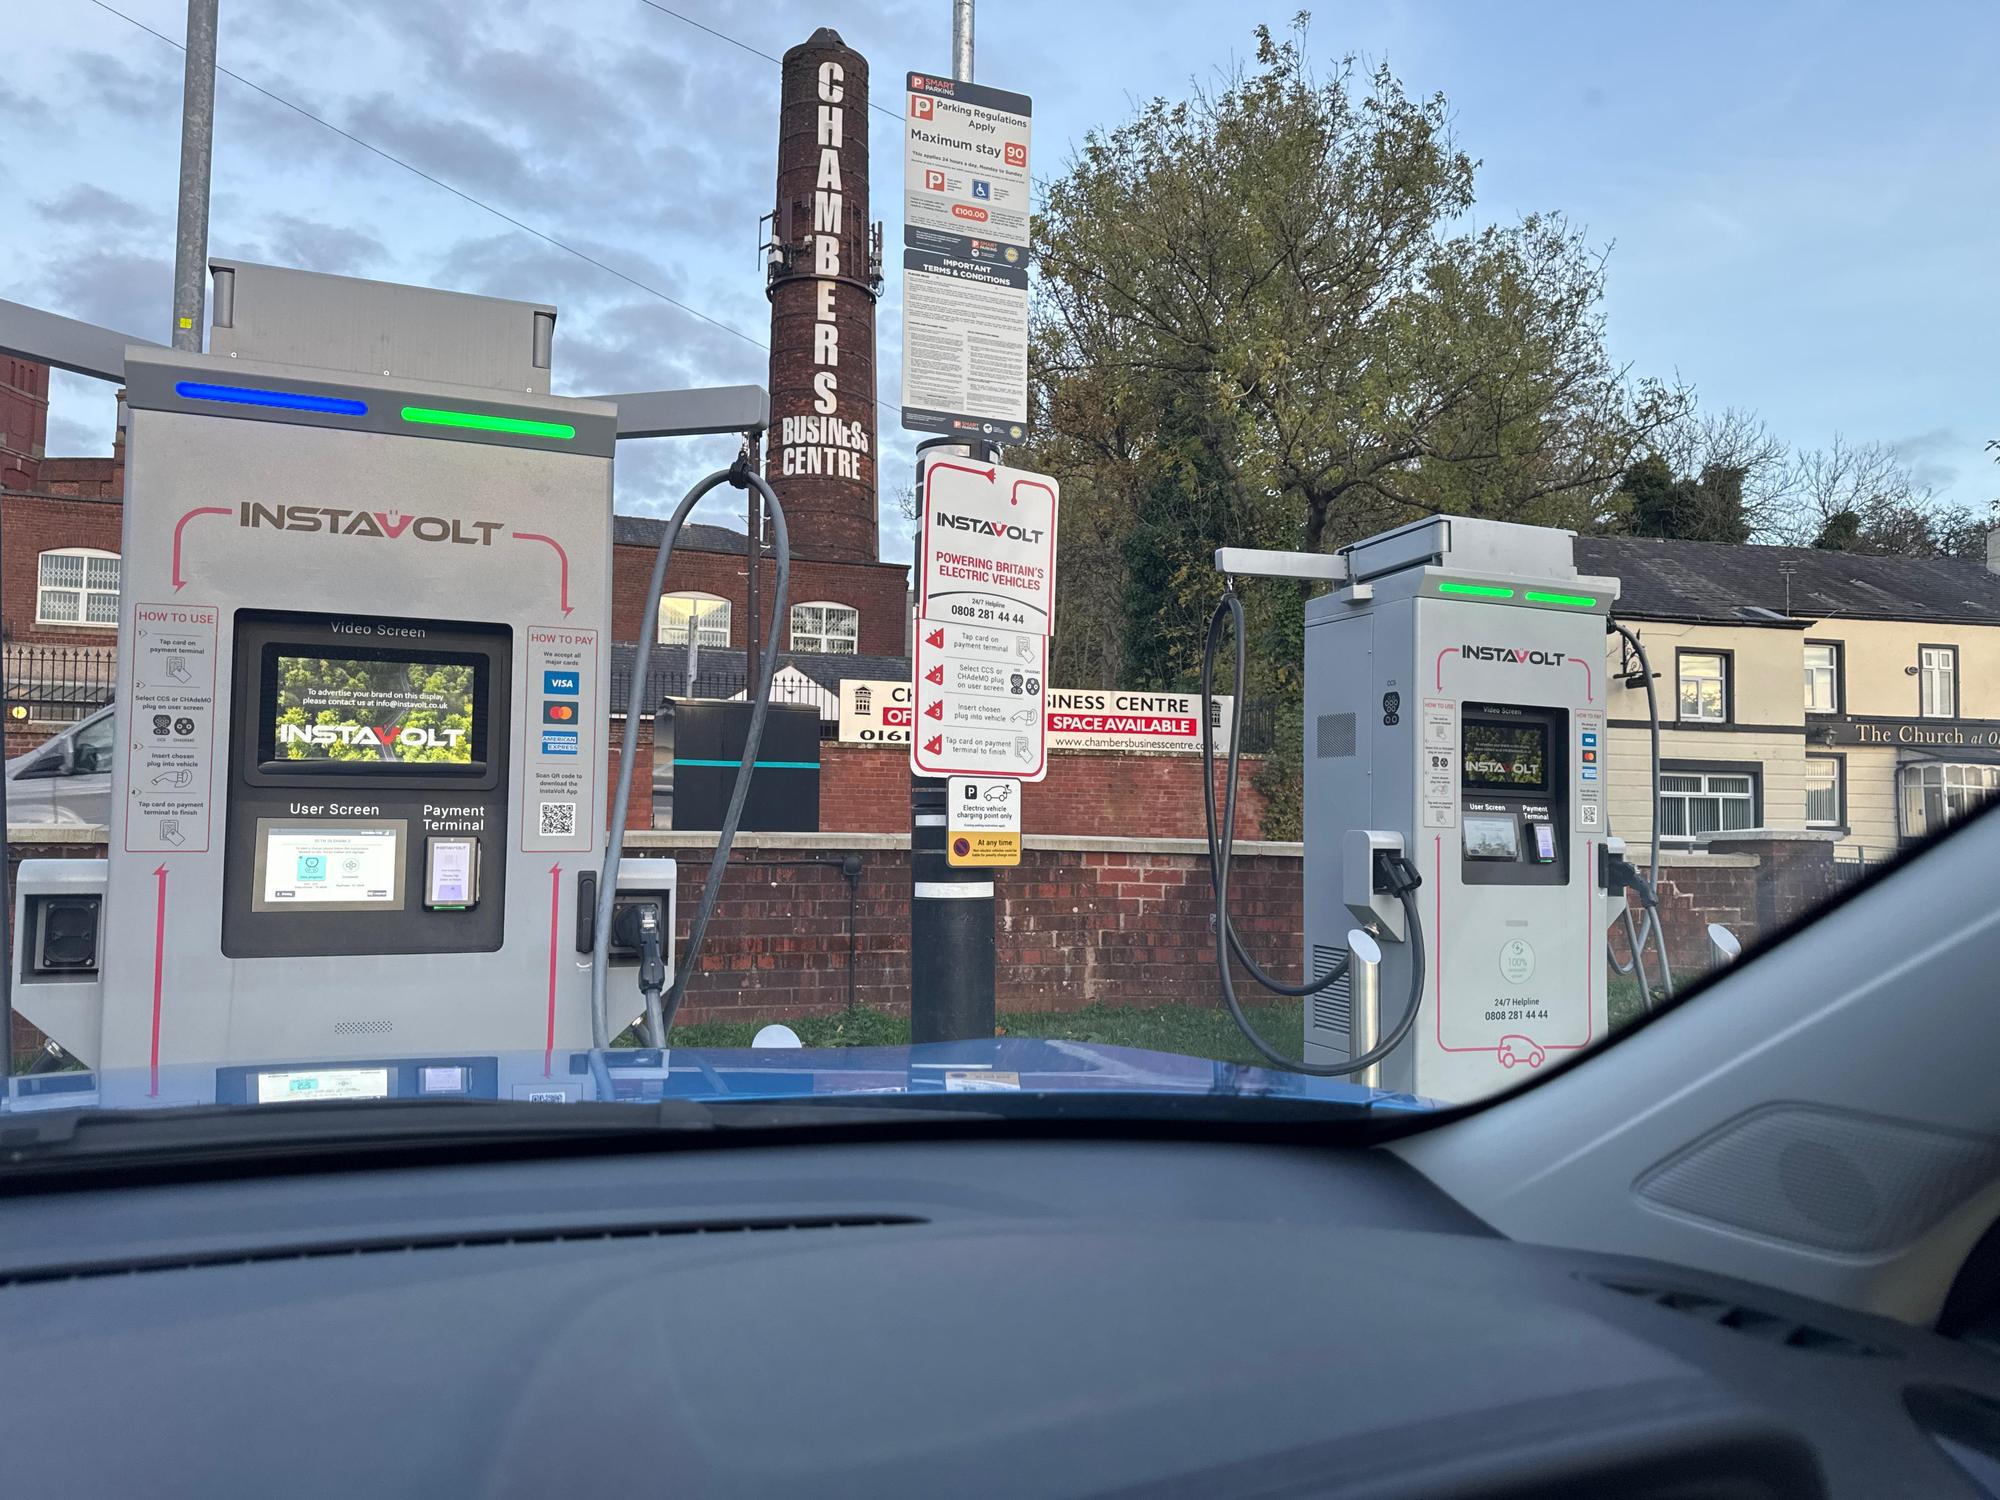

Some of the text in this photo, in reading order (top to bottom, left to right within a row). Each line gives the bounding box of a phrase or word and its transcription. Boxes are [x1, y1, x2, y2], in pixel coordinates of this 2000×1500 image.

[925, 78, 955, 89] SMART
[925, 84, 955, 96] PARKING
[936, 100, 1027, 128] Parking Regulations
[968, 119, 996, 134] Apply
[911, 128, 1002, 159] Maximum stay
[1007, 146, 1024, 159] 90
[955, 207, 985, 219] £100.00
[813, 61, 845, 415] CHAMBERS
[943, 258, 992, 273] IMPORTANT
[922, 263, 951, 275] TERMS
[960, 271, 1011, 286] CONDITIONS
[782, 415, 869, 453] BUSINESS
[782, 446, 861, 480] CENTRE
[240, 501, 505, 547] INSTAVOLT
[937, 511, 1044, 544] INSTAVOLT
[936, 551, 1044, 579] POWERING BRITAIN'S
[939, 565, 1041, 591] ELECTRIC VEHICLES
[972, 598, 1006, 609] 24/7 Helpline
[138, 612, 214, 624] HOW TO USE
[951, 604, 1025, 624] 0808 281 44 44
[330, 621, 426, 638] Video Screen
[531, 633, 594, 645] HOW TO PAY
[962, 632, 973, 642] Tap
[975, 634, 989, 642] card
[953, 640, 1009, 652] payment terminal
[1462, 644, 1566, 667] INSTAVOLT
[959, 664, 980, 673] Select
[981, 666, 995, 674] CCS
[935, 672, 941, 681] 2
[957, 672, 1005, 685] CHAdeMO plug
[551, 679, 574, 688] VISA
[308, 687, 316, 696] To
[318, 689, 352, 697] advertise
[352, 690, 370, 698] your
[371, 690, 393, 699] brand
[404, 692, 418, 700] this
[419, 692, 444, 701] display
[302, 697, 327, 705] please
[376, 700, 448, 709] info@instavolt.co.uk
[957, 703, 1001, 713] Insert chosen
[1115, 696, 1189, 713] CENTRE
[935, 708, 941, 716] 3
[1483, 706, 1522, 715] Video Screen
[954, 712, 1006, 722] plug into vehicle
[1053, 716, 1190, 733] SPACE AVAILABLE
[280, 723, 466, 747] INSTAVOLT
[542, 735, 577, 743] AMERICAN
[860, 729, 910, 742] 0161
[1855, 724, 2000, 745] The Church at O
[934, 742, 940, 750] 4
[946, 737, 957, 745] Tap
[984, 740, 1012, 749] payment
[952, 746, 1007, 756] terminal finish
[1465, 760, 1539, 775] INSTAVOLT
[290, 803, 380, 816] User Screen
[423, 804, 485, 819] Payment
[1469, 803, 1506, 811] User Screen
[1522, 804, 1548, 813] Payment
[956, 811, 983, 820] charging
[1523, 812, 1549, 820] Terminal
[423, 819, 485, 831] Terminal
[986, 840, 998, 848] any
[1494, 997, 1540, 1007] 24/7 Helpline
[1484, 1010, 1548, 1021] 0808 281 44 44
